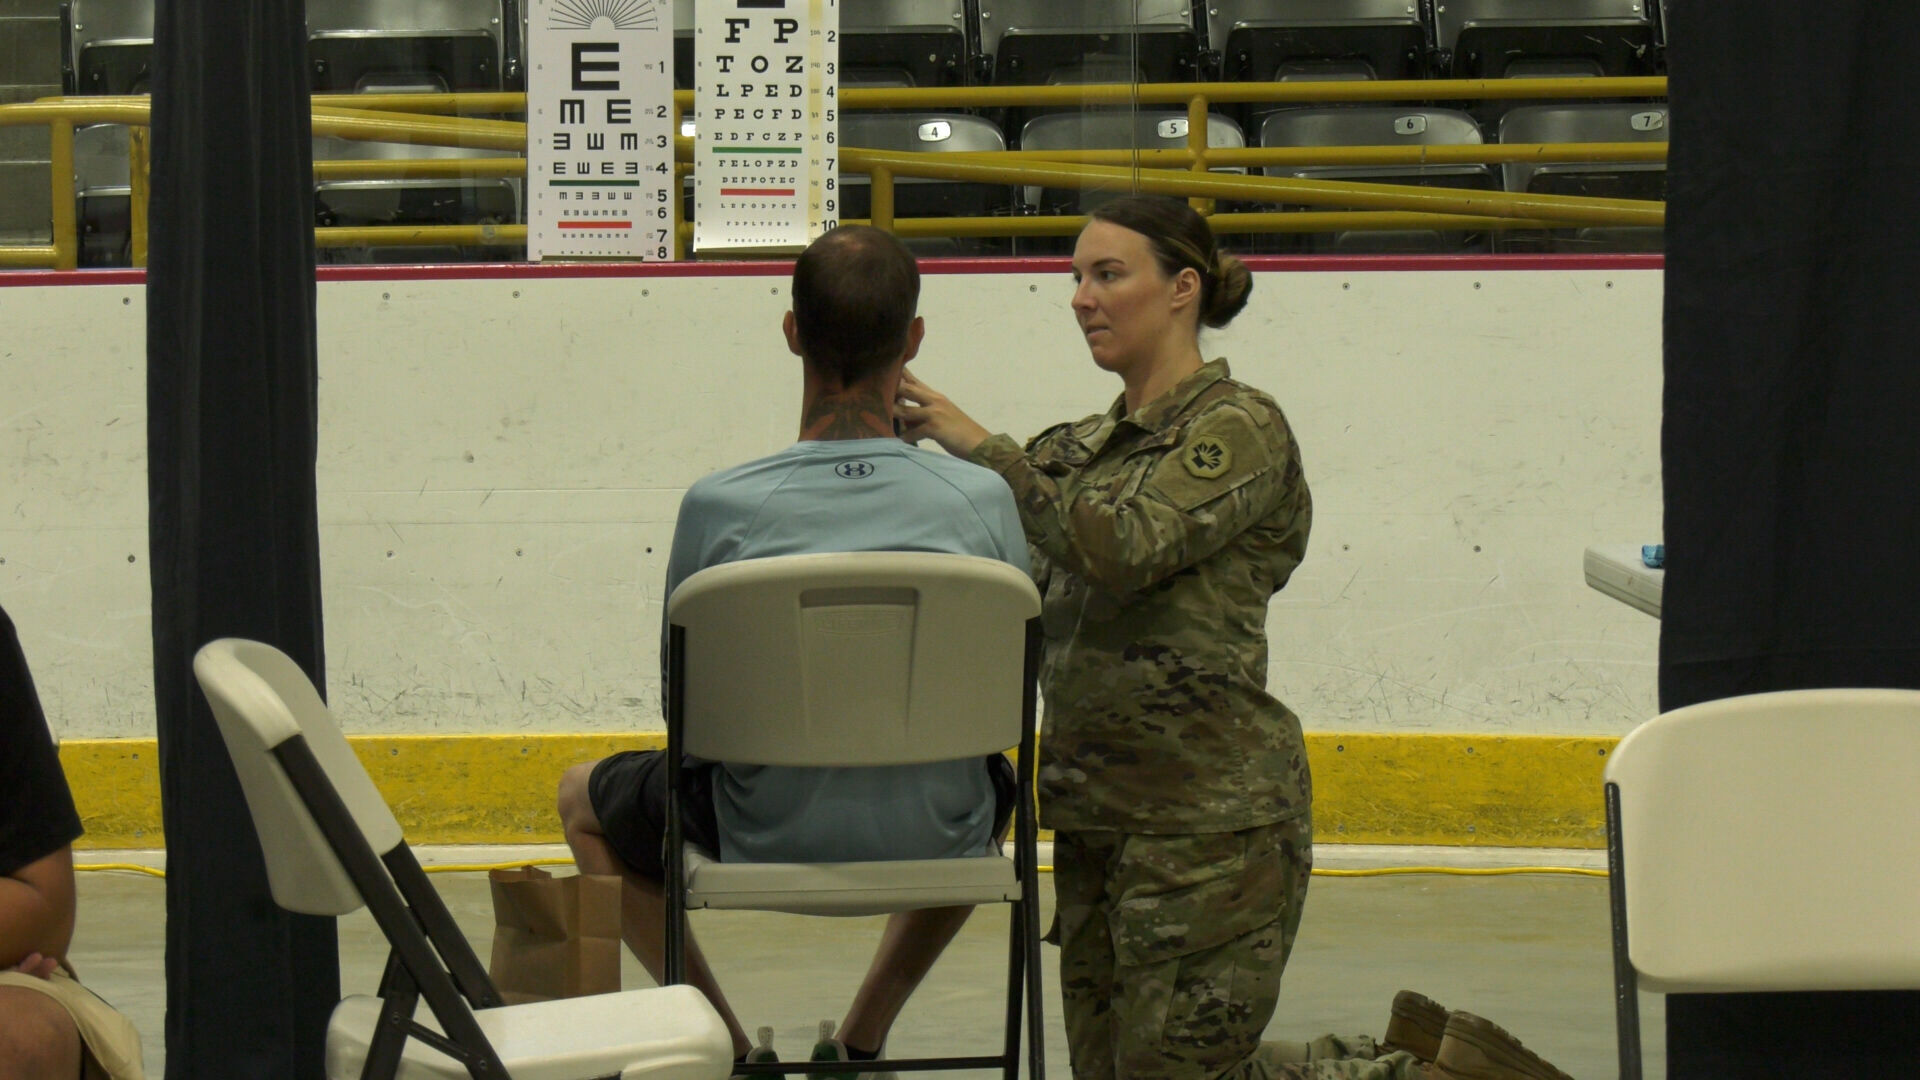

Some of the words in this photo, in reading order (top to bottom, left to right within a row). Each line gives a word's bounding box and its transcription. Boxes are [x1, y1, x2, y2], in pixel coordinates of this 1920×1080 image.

[827, 30, 836, 42] 2
[571, 42, 620, 91] E
[659, 61, 664, 74] 1
[826, 62, 835, 75] 3
[826, 86, 835, 98] 4
[656, 105, 667, 118] 2
[826, 110, 835, 121] 5
[1406, 118, 1414, 129] 6
[1643, 115, 1651, 127] 7
[931, 126, 939, 138] 4
[1170, 123, 1178, 134] 5
[656, 135, 667, 148] 3
[826, 132, 835, 144] 6
[656, 162, 668, 174] 4
[826, 159, 835, 171] 7
[826, 178, 835, 190] 8
[657, 189, 667, 202] 5
[826, 200, 835, 211] 9
[657, 207, 667, 219] 6
[821, 220, 837, 231] 10
[656, 229, 667, 242] 7
[657, 246, 667, 259] 8
